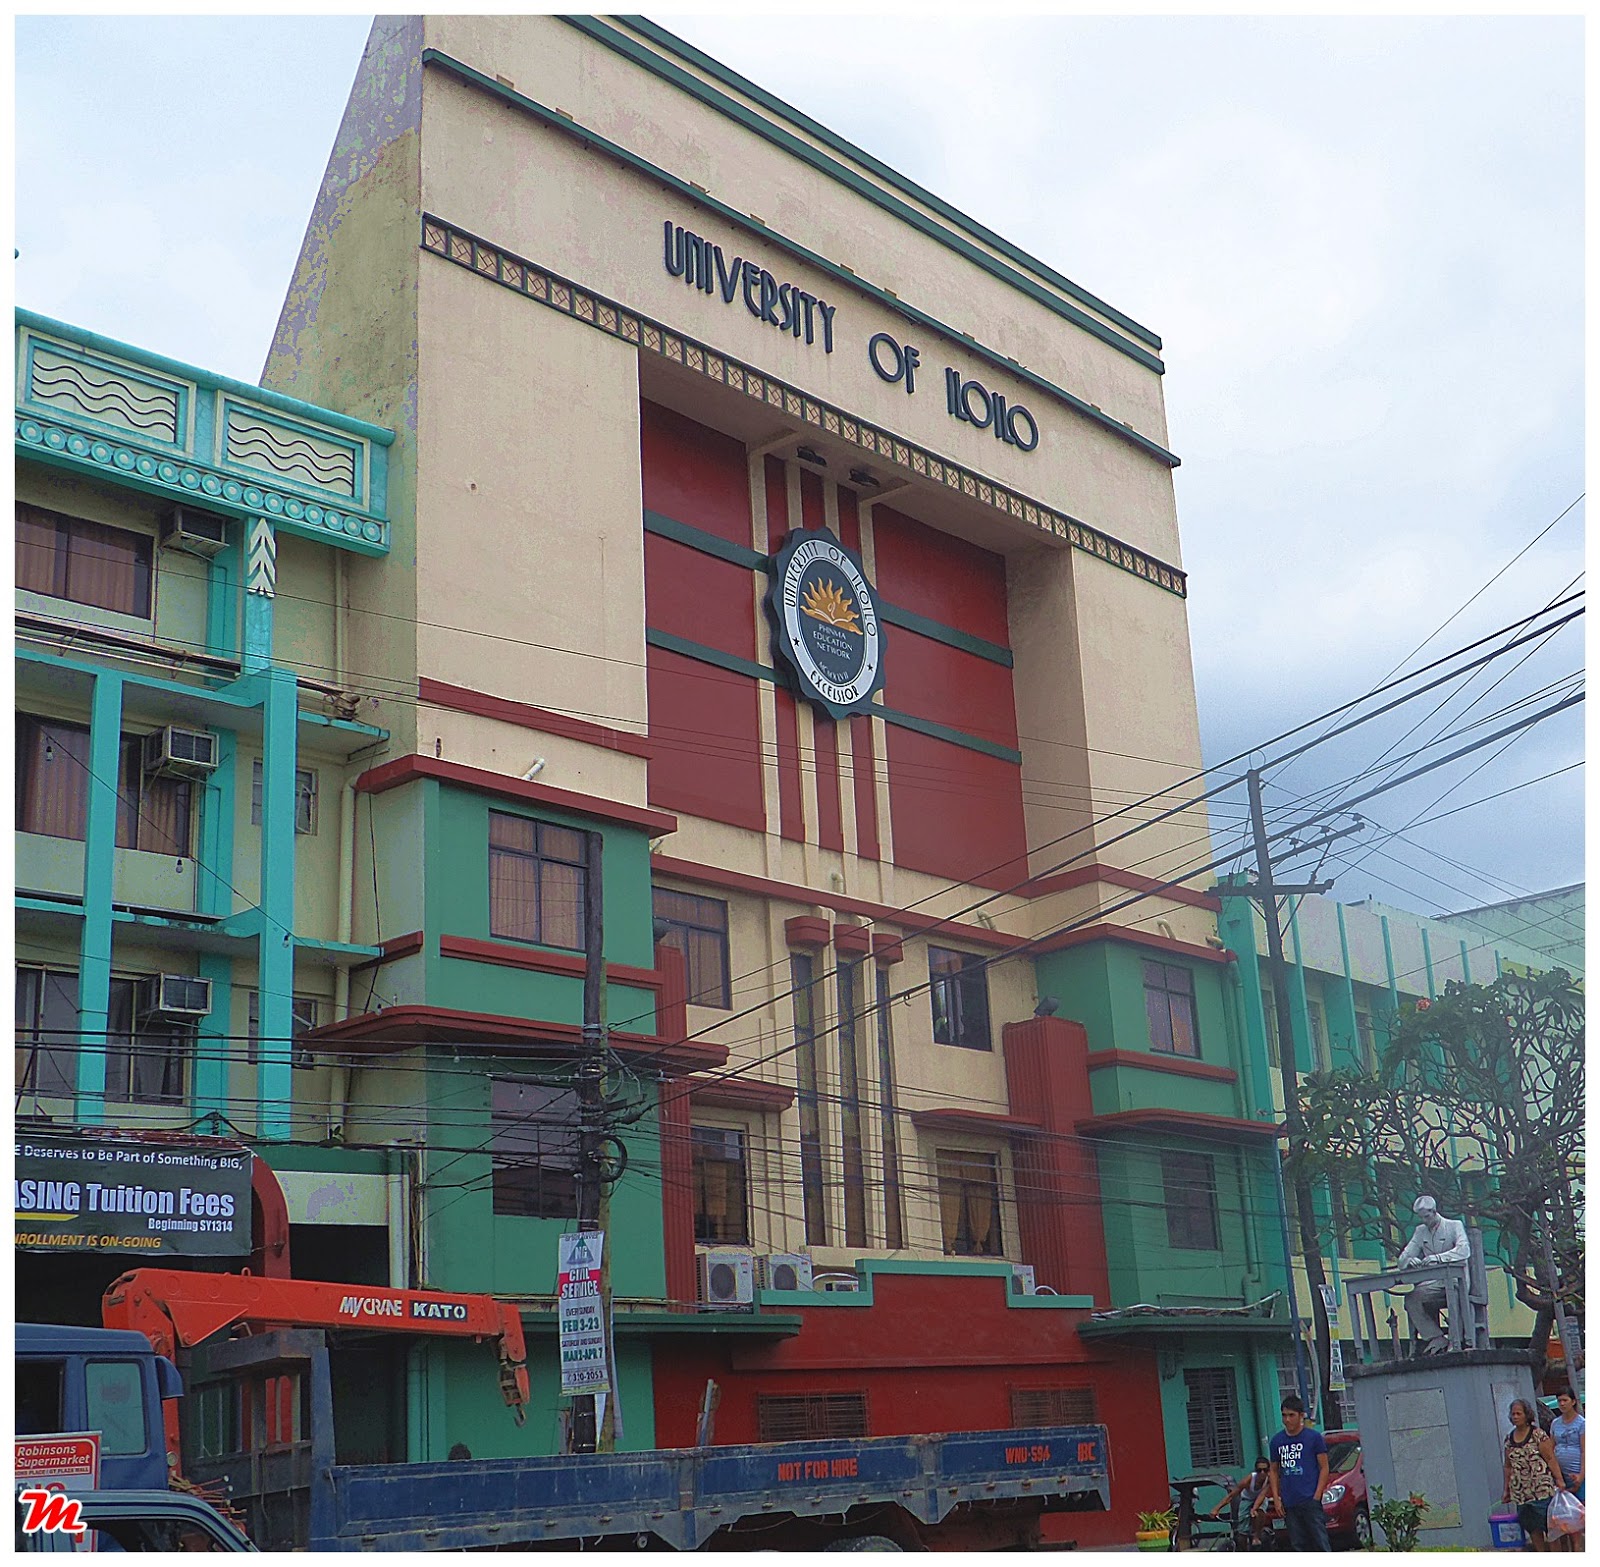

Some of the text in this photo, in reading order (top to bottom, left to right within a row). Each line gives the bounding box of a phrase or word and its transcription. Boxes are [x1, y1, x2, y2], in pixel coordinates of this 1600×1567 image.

[664, 220, 1040, 452] UNIVERSITY OF ILOILO
[785, 541, 876, 637] UNIVERSITY OF ILOILO
[813, 630, 853, 652] EDUCATION
[818, 624, 847, 640] PHINMA
[816, 641, 851, 660] NETWORK
[810, 670, 860, 703] EXCELSIOR
[24, 1145, 79, 1159] Deserves
[82, 1149, 95, 1160] to
[98, 1149, 113, 1161] Be
[116, 1151, 140, 1162] Part
[142, 1152, 156, 1164] of
[157, 1153, 217, 1170] Something
[220, 1157, 243, 1170] BIG,
[86, 1183, 174, 1214] Tuition
[180, 1188, 235, 1217] Fees
[148, 1218, 233, 1232] Beginning SY1314
[87, 1235, 98, 1246] IS
[100, 1236, 162, 1248] ON-GOING
[561, 1280, 600, 1299] SERVICE
[413, 1302, 466, 1319] KATO
[562, 1317, 600, 1332] FEB 3-23
[17, 1445, 77, 1456] Robinsons
[1281, 1451, 1301, 1460] HIGH
[1290, 1442, 1304, 1452] SO
[16, 1454, 90, 1469] Supermarket
[778, 1457, 858, 1481] NOT FOR HIRE
